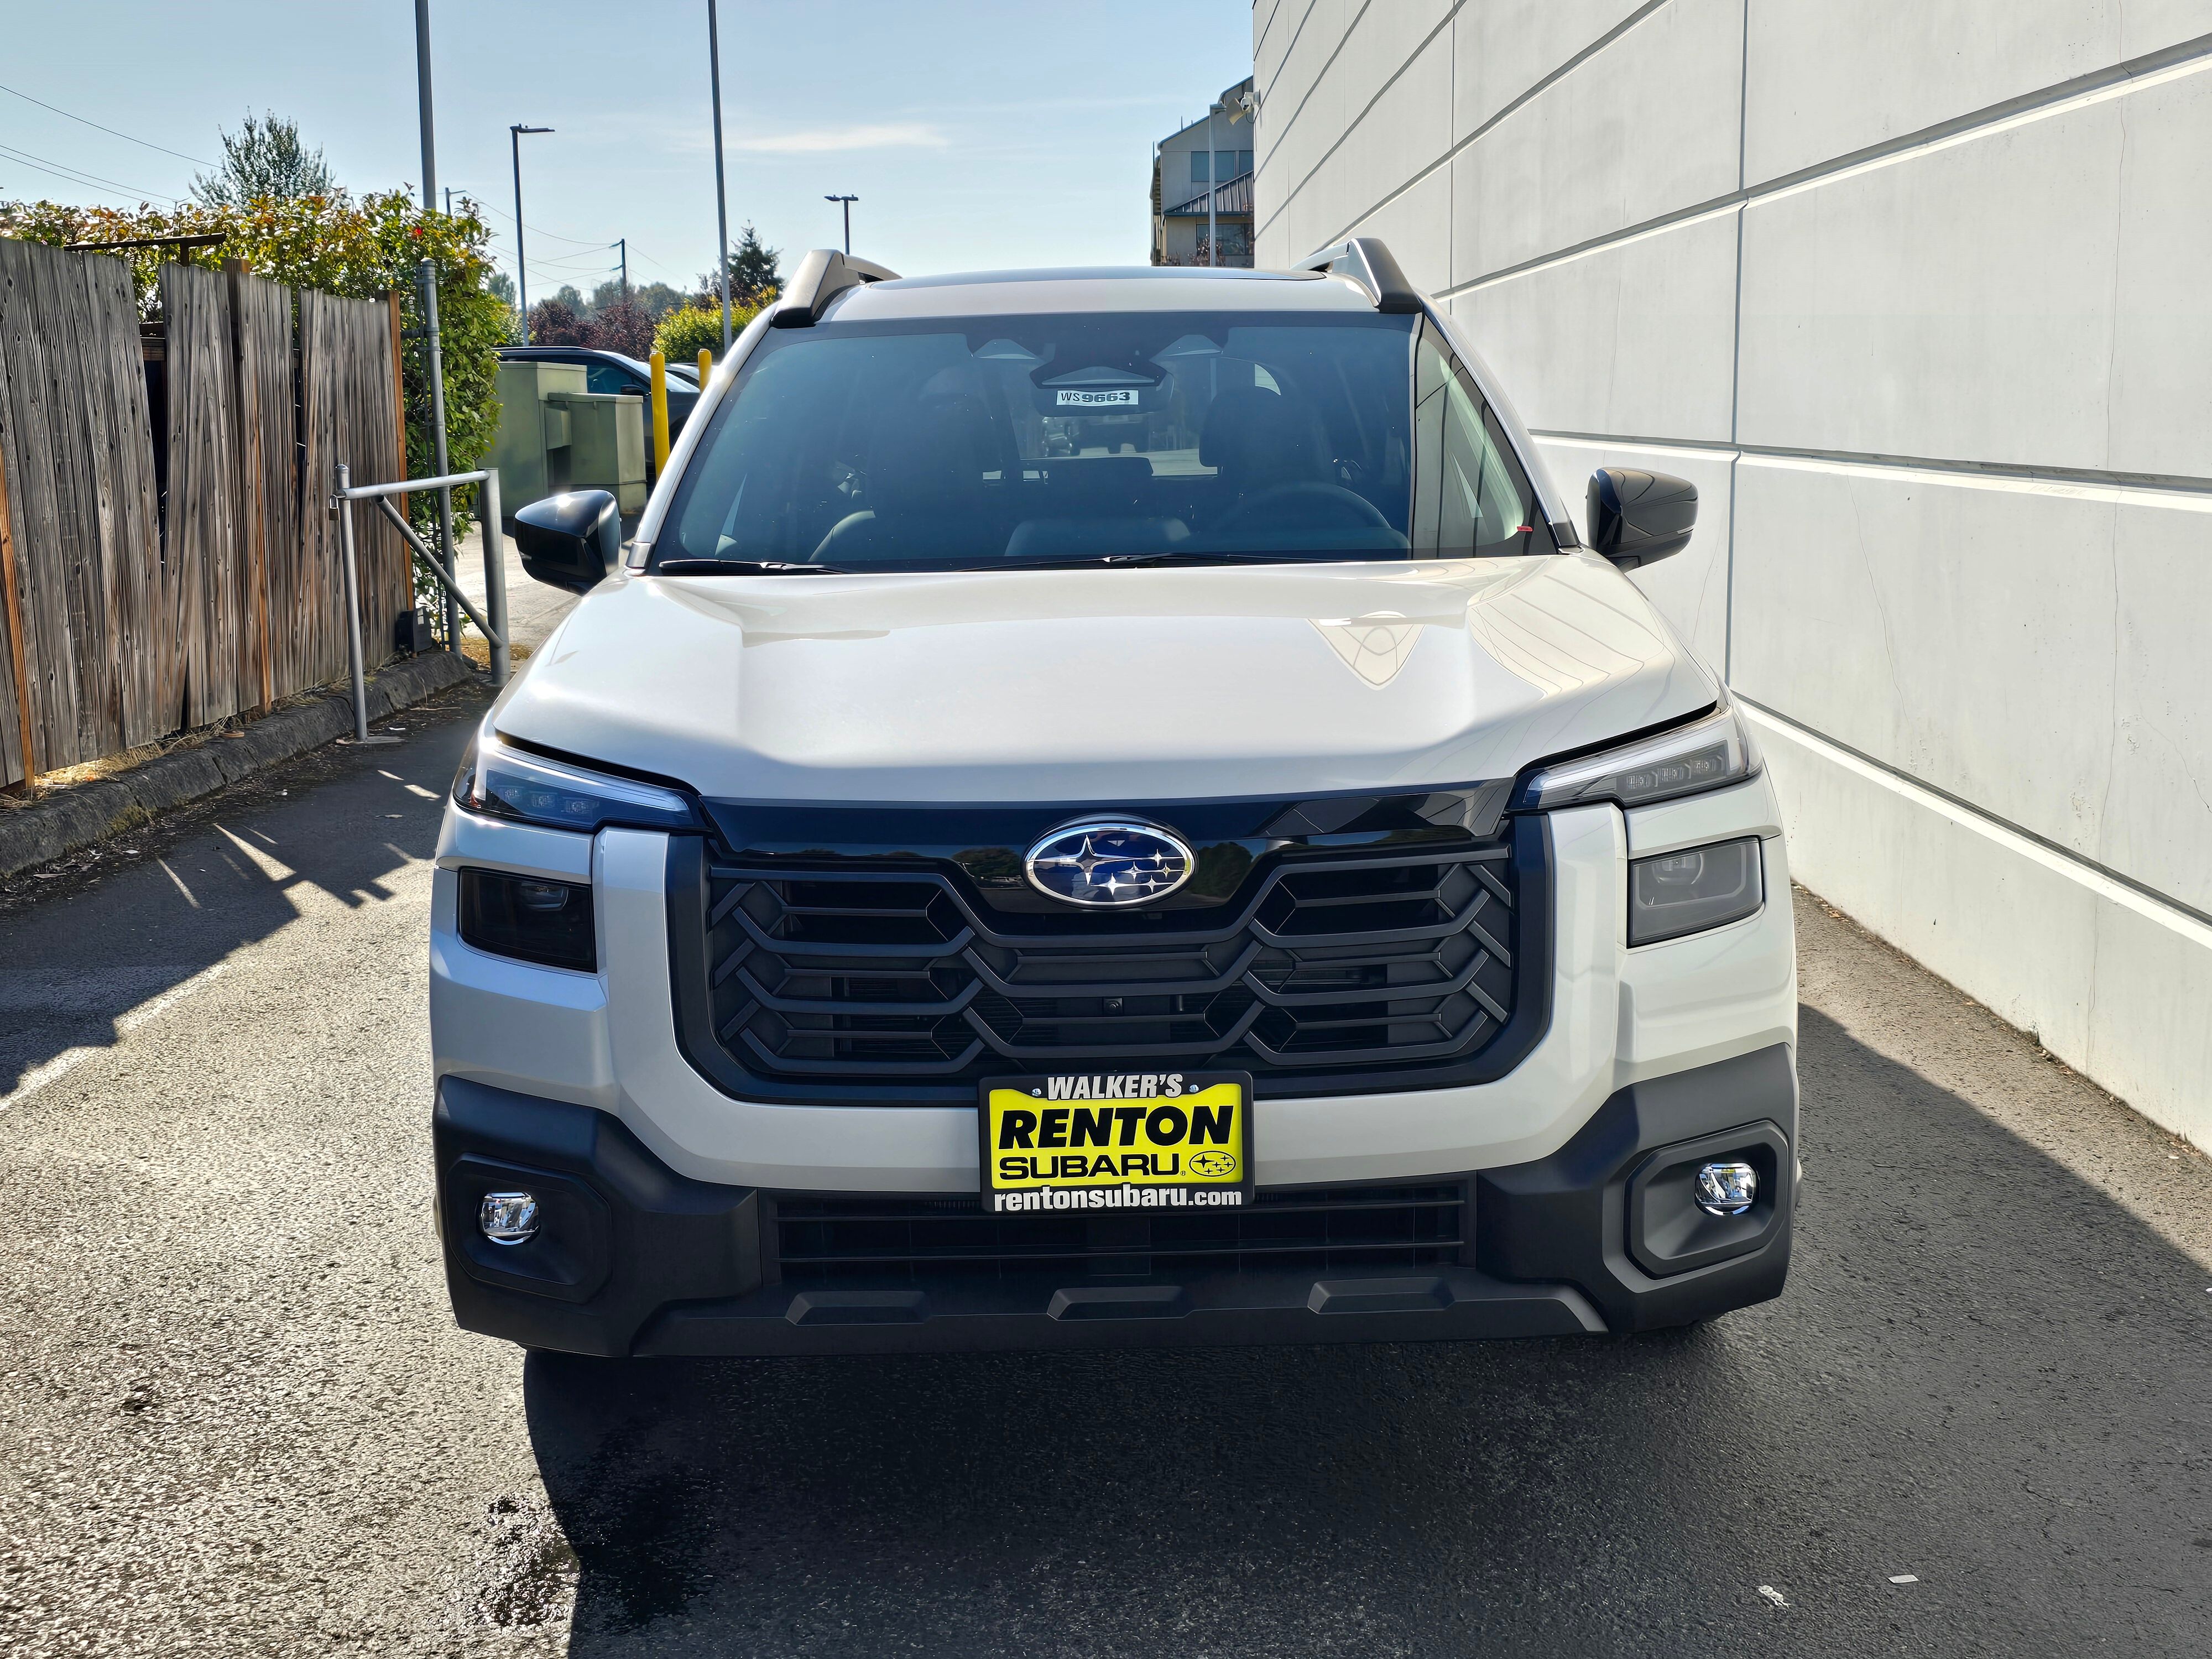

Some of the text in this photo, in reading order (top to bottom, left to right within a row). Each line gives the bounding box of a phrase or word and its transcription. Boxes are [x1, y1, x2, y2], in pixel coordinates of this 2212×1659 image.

[1061, 392, 1130, 403] WS9663
[1047, 1073, 1183, 1100] WALKER'S
[998, 1105, 1234, 1150] RENTON
[999, 1153, 1180, 1180] SUBARU
[994, 1183, 1242, 1212] rentonsubaru.com
